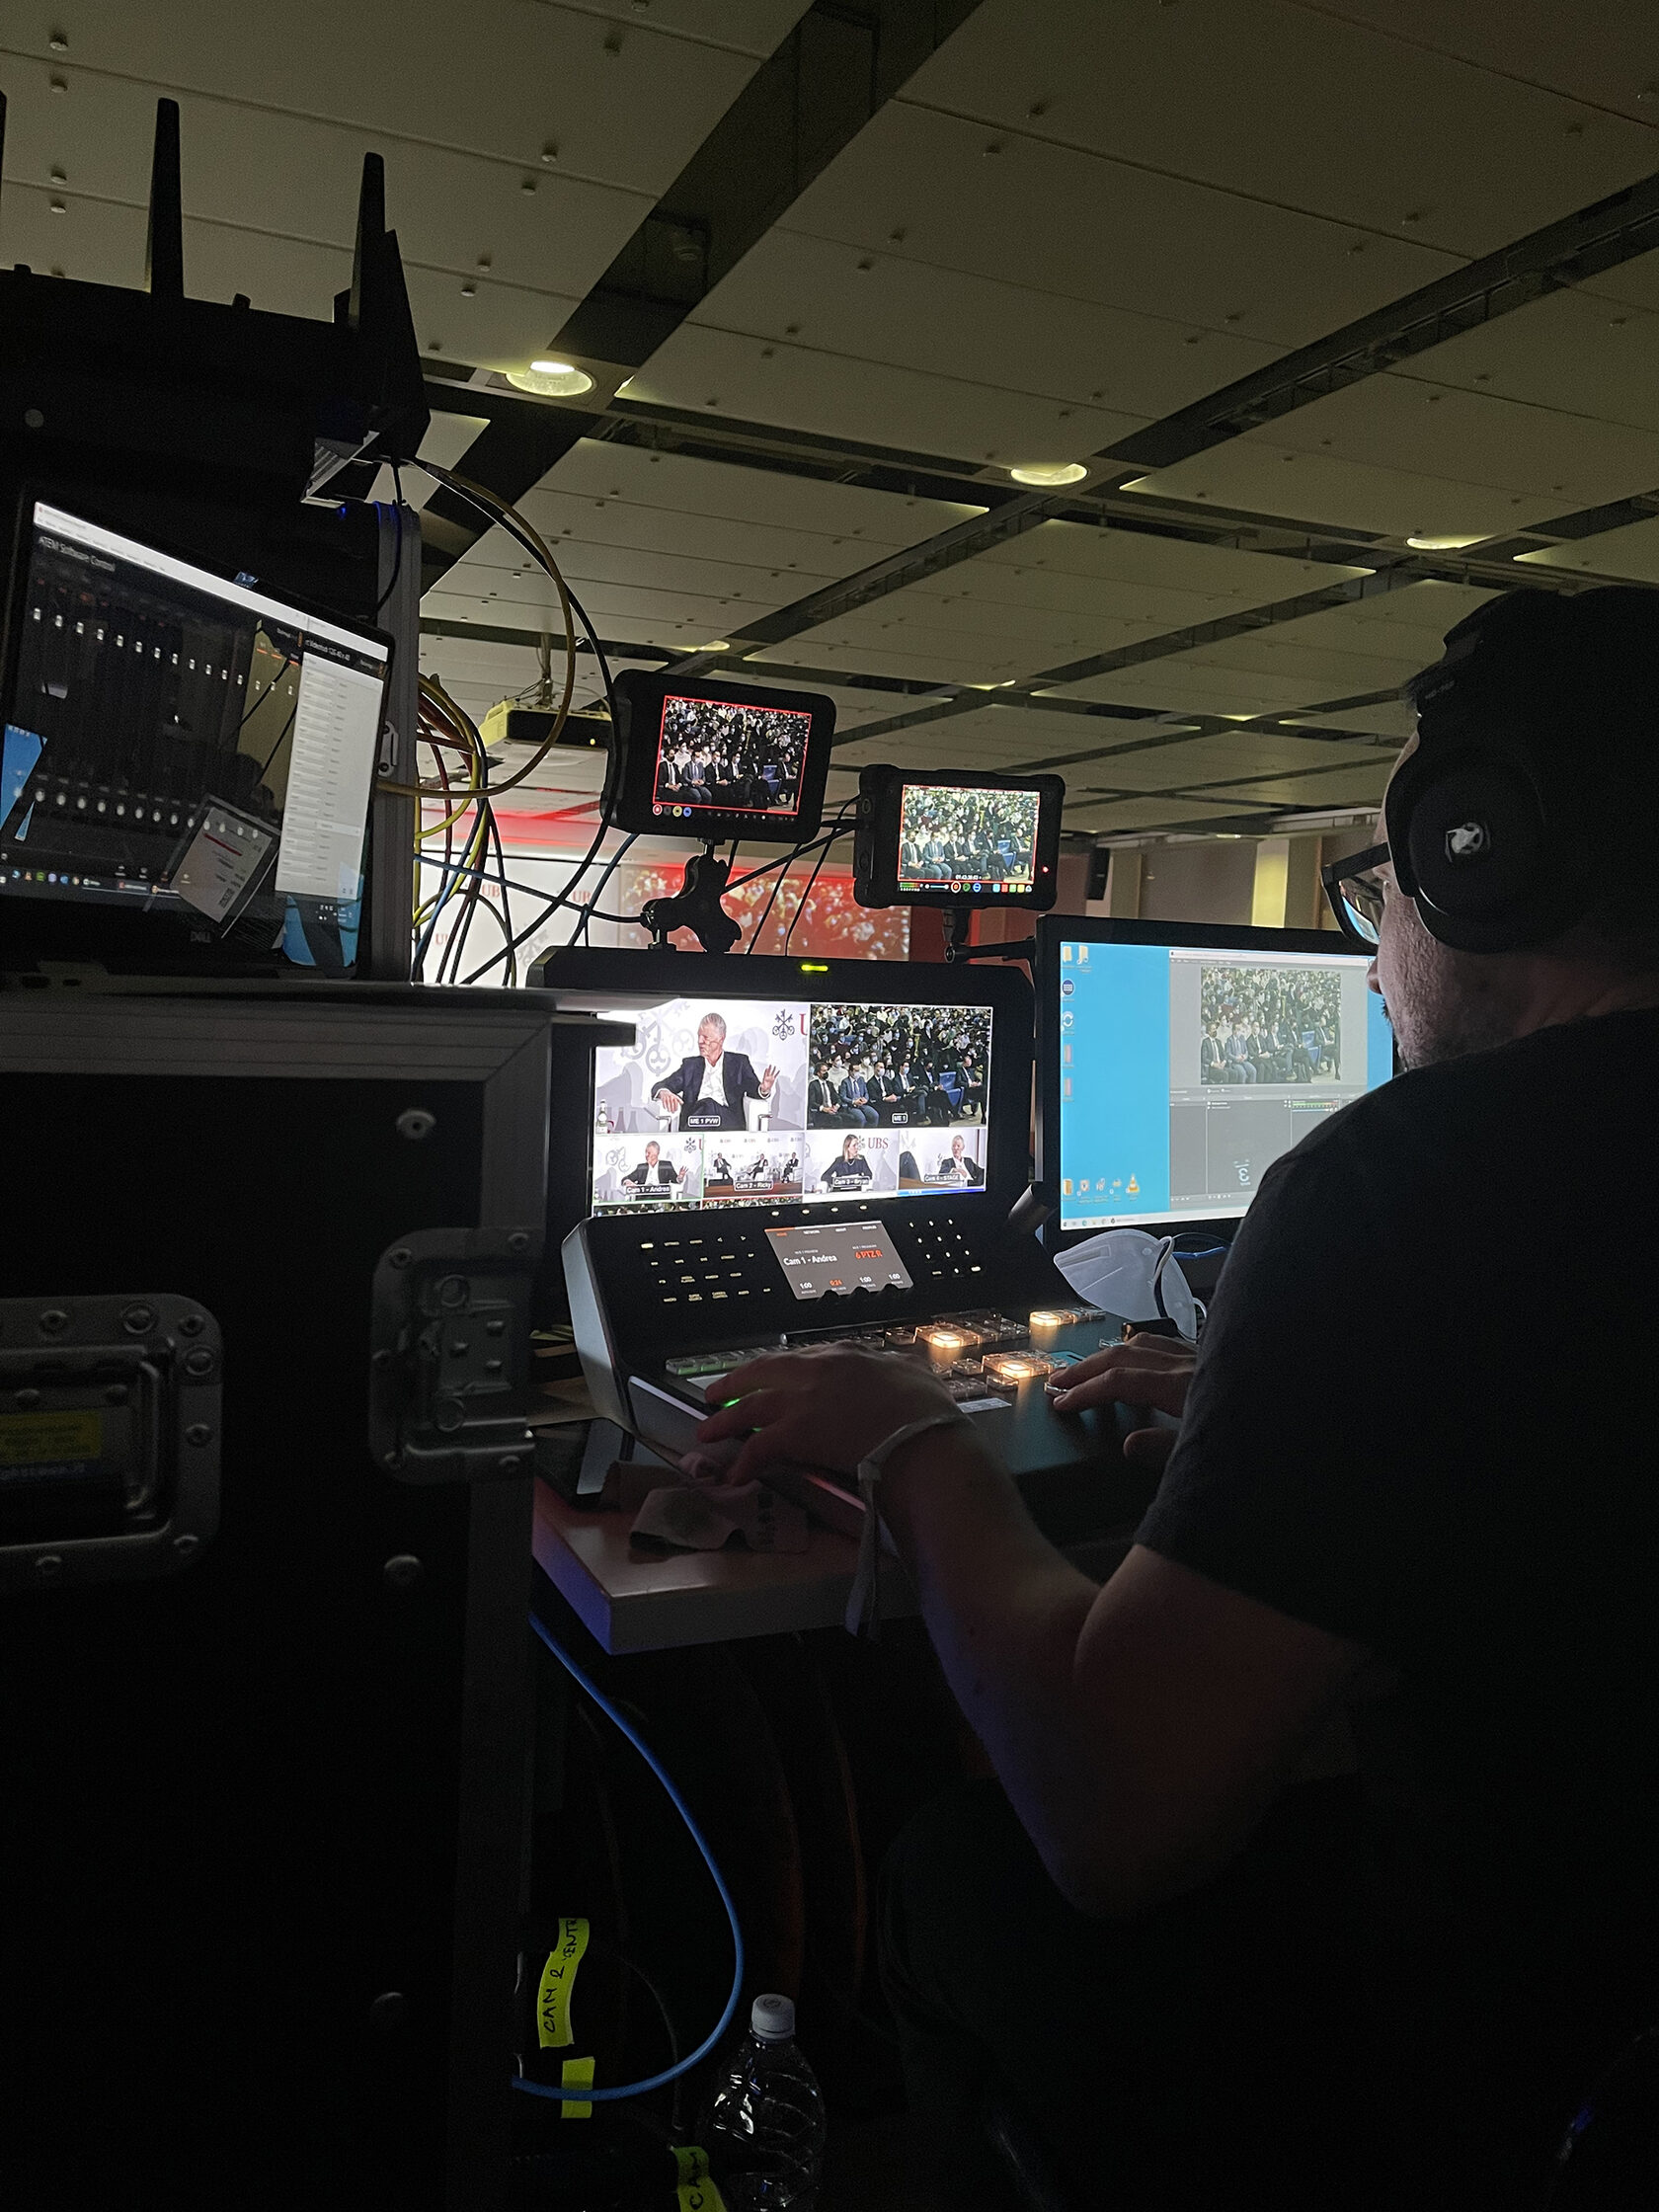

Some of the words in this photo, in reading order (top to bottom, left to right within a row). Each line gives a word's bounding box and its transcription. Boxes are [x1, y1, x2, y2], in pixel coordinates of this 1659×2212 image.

[481, 884, 501, 898] UB
[573, 891, 592, 904] UB
[868, 1137, 889, 1149] UBS
[783, 1257, 801, 1266] Cam
[812, 1254, 837, 1263] Andrea
[542, 1987, 557, 2032] CAM
[550, 1965, 565, 1979] 2
